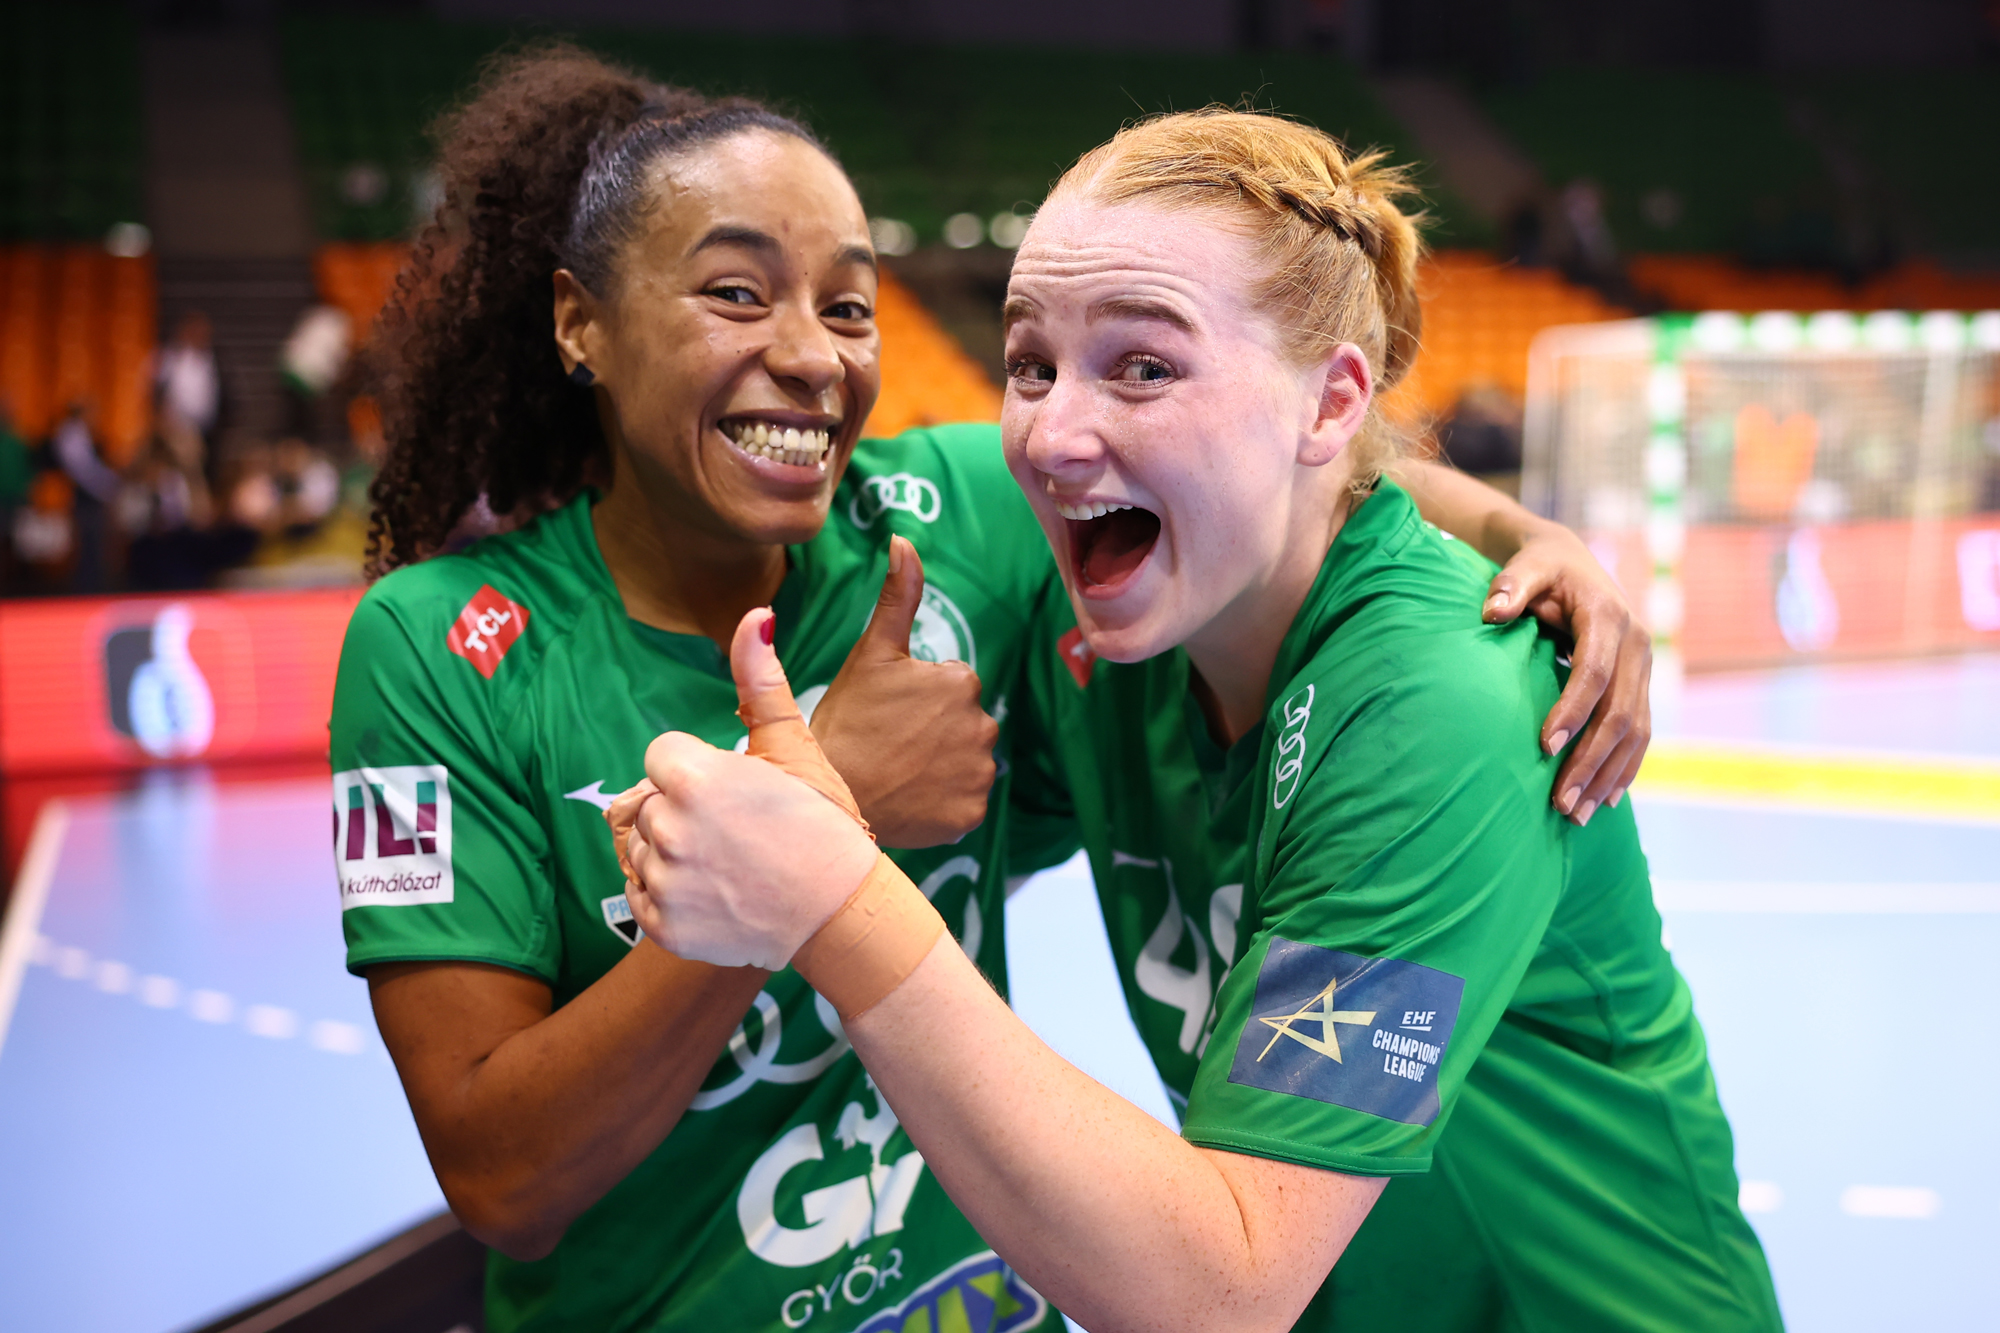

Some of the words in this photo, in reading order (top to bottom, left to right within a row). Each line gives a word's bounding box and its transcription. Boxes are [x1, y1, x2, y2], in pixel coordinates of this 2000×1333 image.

[464, 606, 512, 653] TCL
[333, 780, 437, 861] IL!
[347, 871, 442, 895] kúthálózat
[1401, 1011, 1436, 1025] EHF
[1372, 1028, 1441, 1065] CHAMPIONS
[1383, 1053, 1427, 1083] LEAGUE
